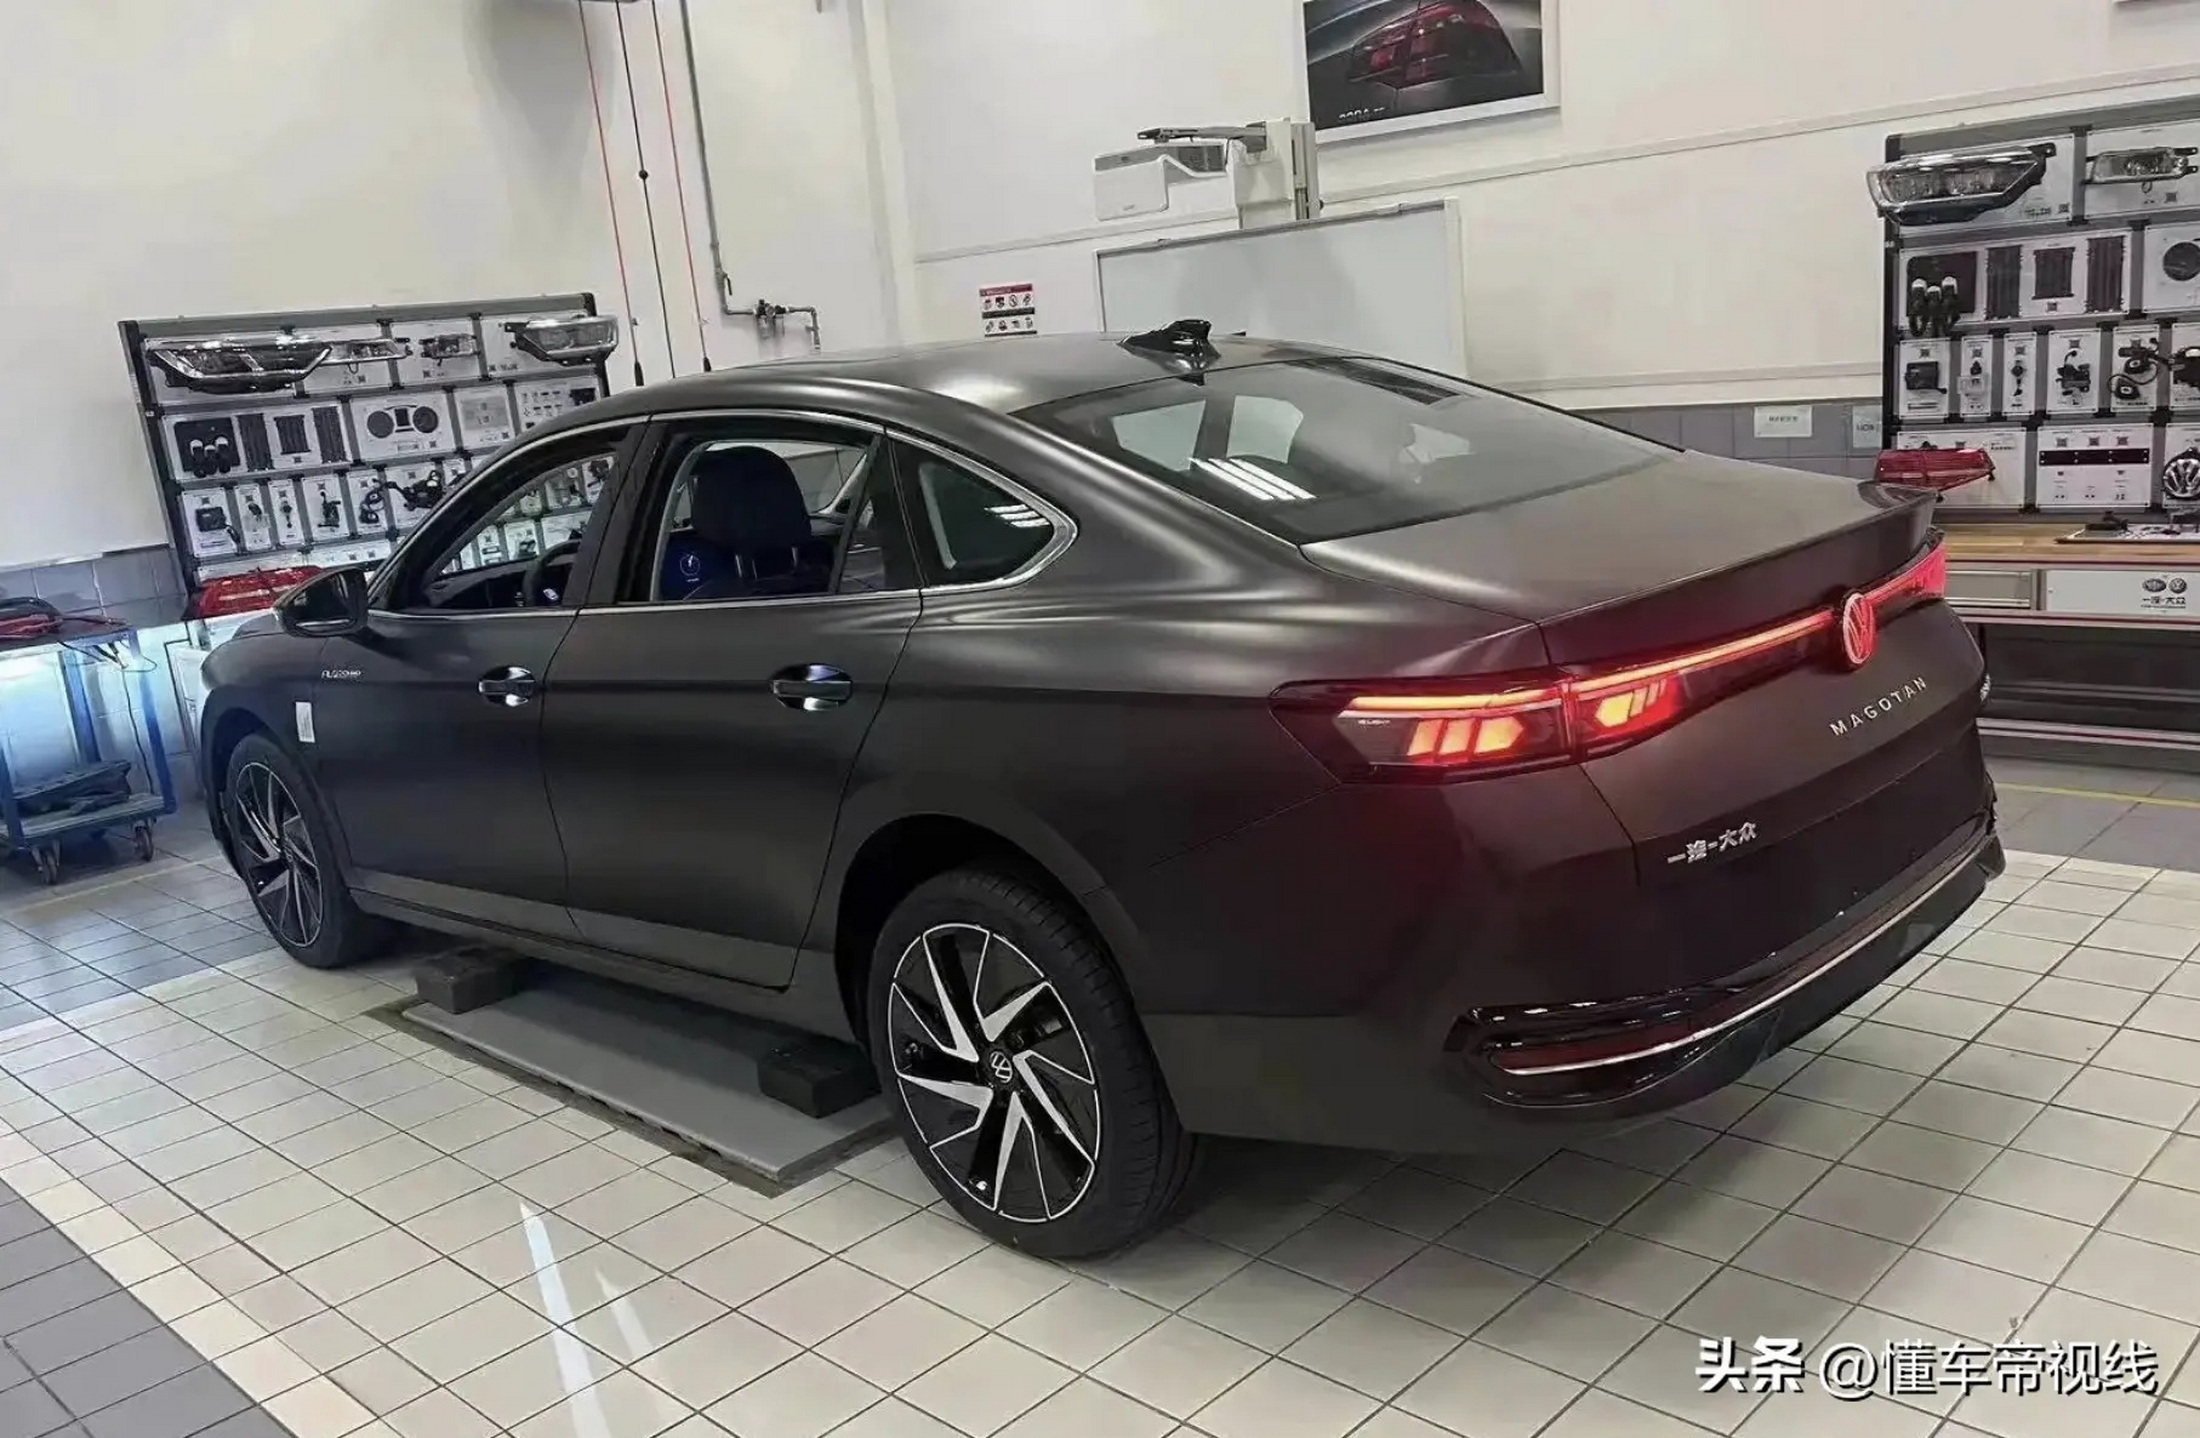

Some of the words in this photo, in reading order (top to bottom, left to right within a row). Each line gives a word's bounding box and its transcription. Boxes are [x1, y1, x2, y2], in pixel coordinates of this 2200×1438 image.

[1829, 676, 1928, 737] MAGOTAN
[1667, 821, 1757, 864] 一汽-大众
